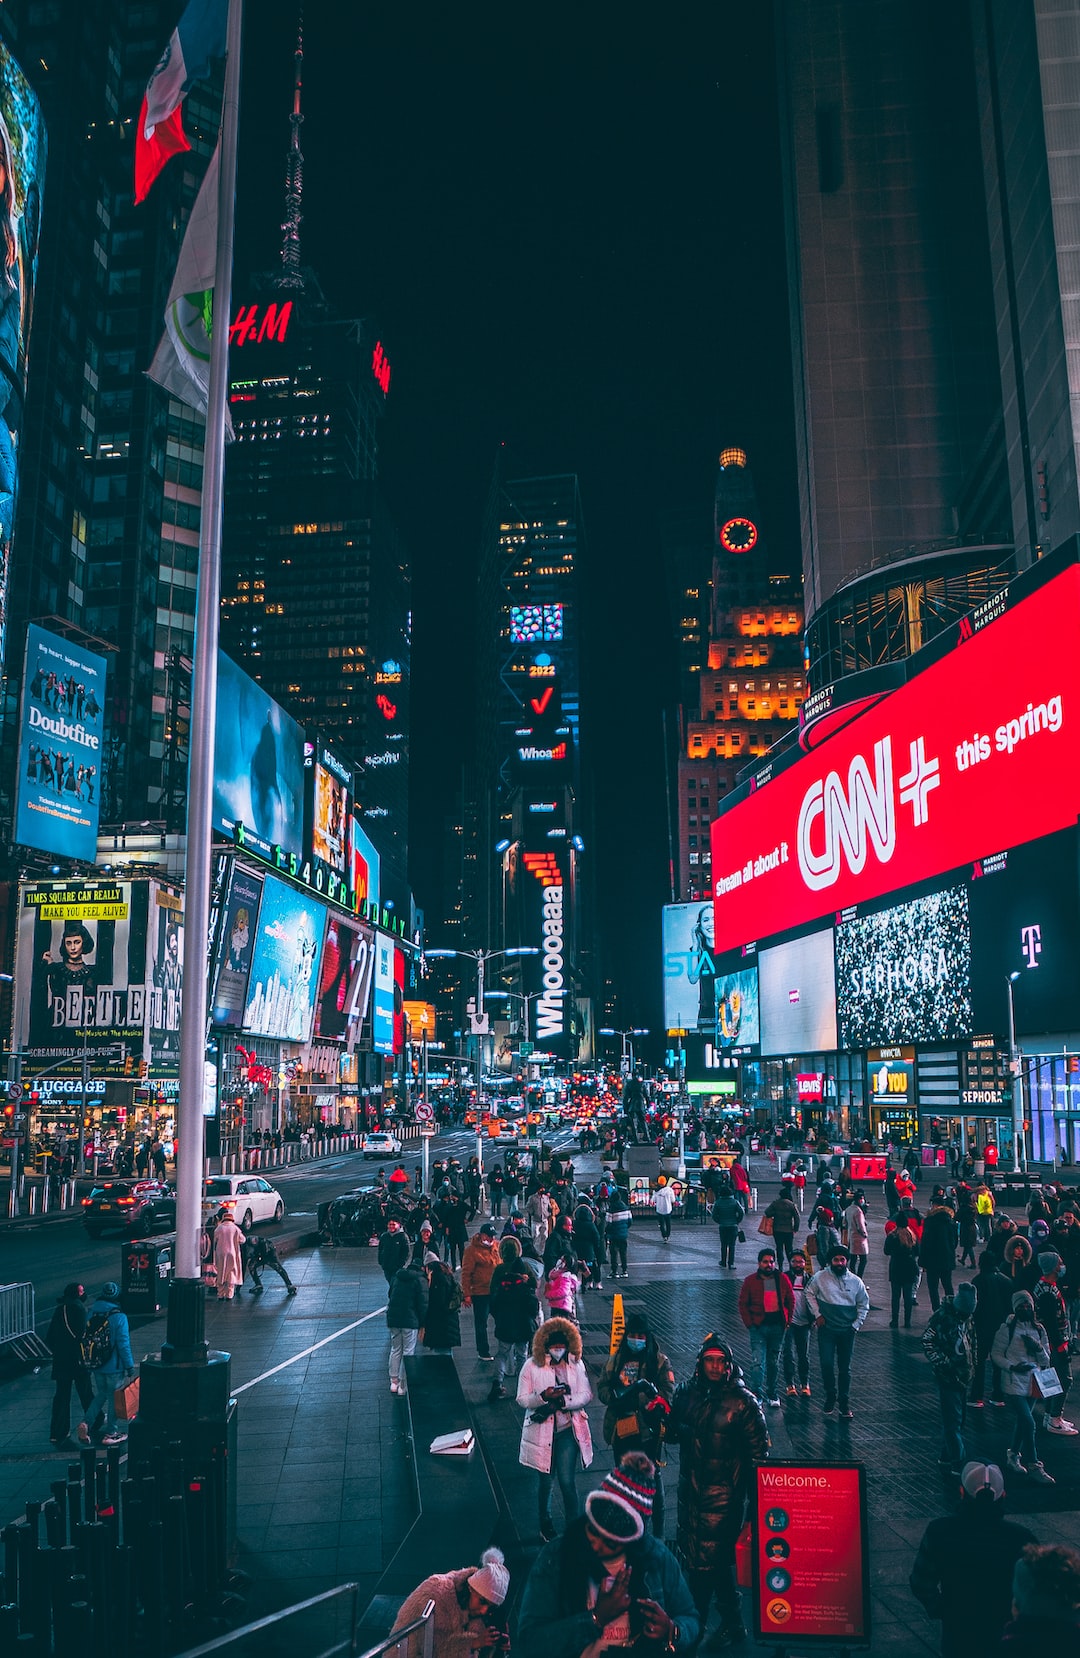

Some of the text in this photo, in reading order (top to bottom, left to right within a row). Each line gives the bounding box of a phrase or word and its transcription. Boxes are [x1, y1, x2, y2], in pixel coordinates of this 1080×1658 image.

[228, 301, 293, 347] H&M
[974, 587, 1009, 620] MARRIOTT
[975, 602, 1006, 631] MARQUIS
[38, 643, 48, 654] Big
[64, 655, 81, 669] bigger
[529, 665, 556, 677] 2022
[804, 685, 835, 710] MARRIOTT
[805, 698, 831, 720] MARQUIS
[28, 705, 99, 750] Doubtfire
[955, 693, 1064, 773] this spring
[716, 841, 789, 897] stream all about it
[983, 851, 1008, 866] MARRIOTT
[983, 861, 1007, 875] MARQUIS
[26, 889, 121, 904] TIMES SQUARE CAN REALLY
[43, 905, 127, 918] MAKE YOU FEEL ALIVE!
[1021, 924, 1042, 969] T
[851, 948, 950, 998] SEPHORA
[972, 1039, 994, 1048] SEPHORA
[33, 1080, 106, 1093] LUGGAGE
[888, 1072, 908, 1093] YOU
[962, 1091, 1003, 1103] SEPHORA
[761, 1472, 831, 1489] Welcome.
